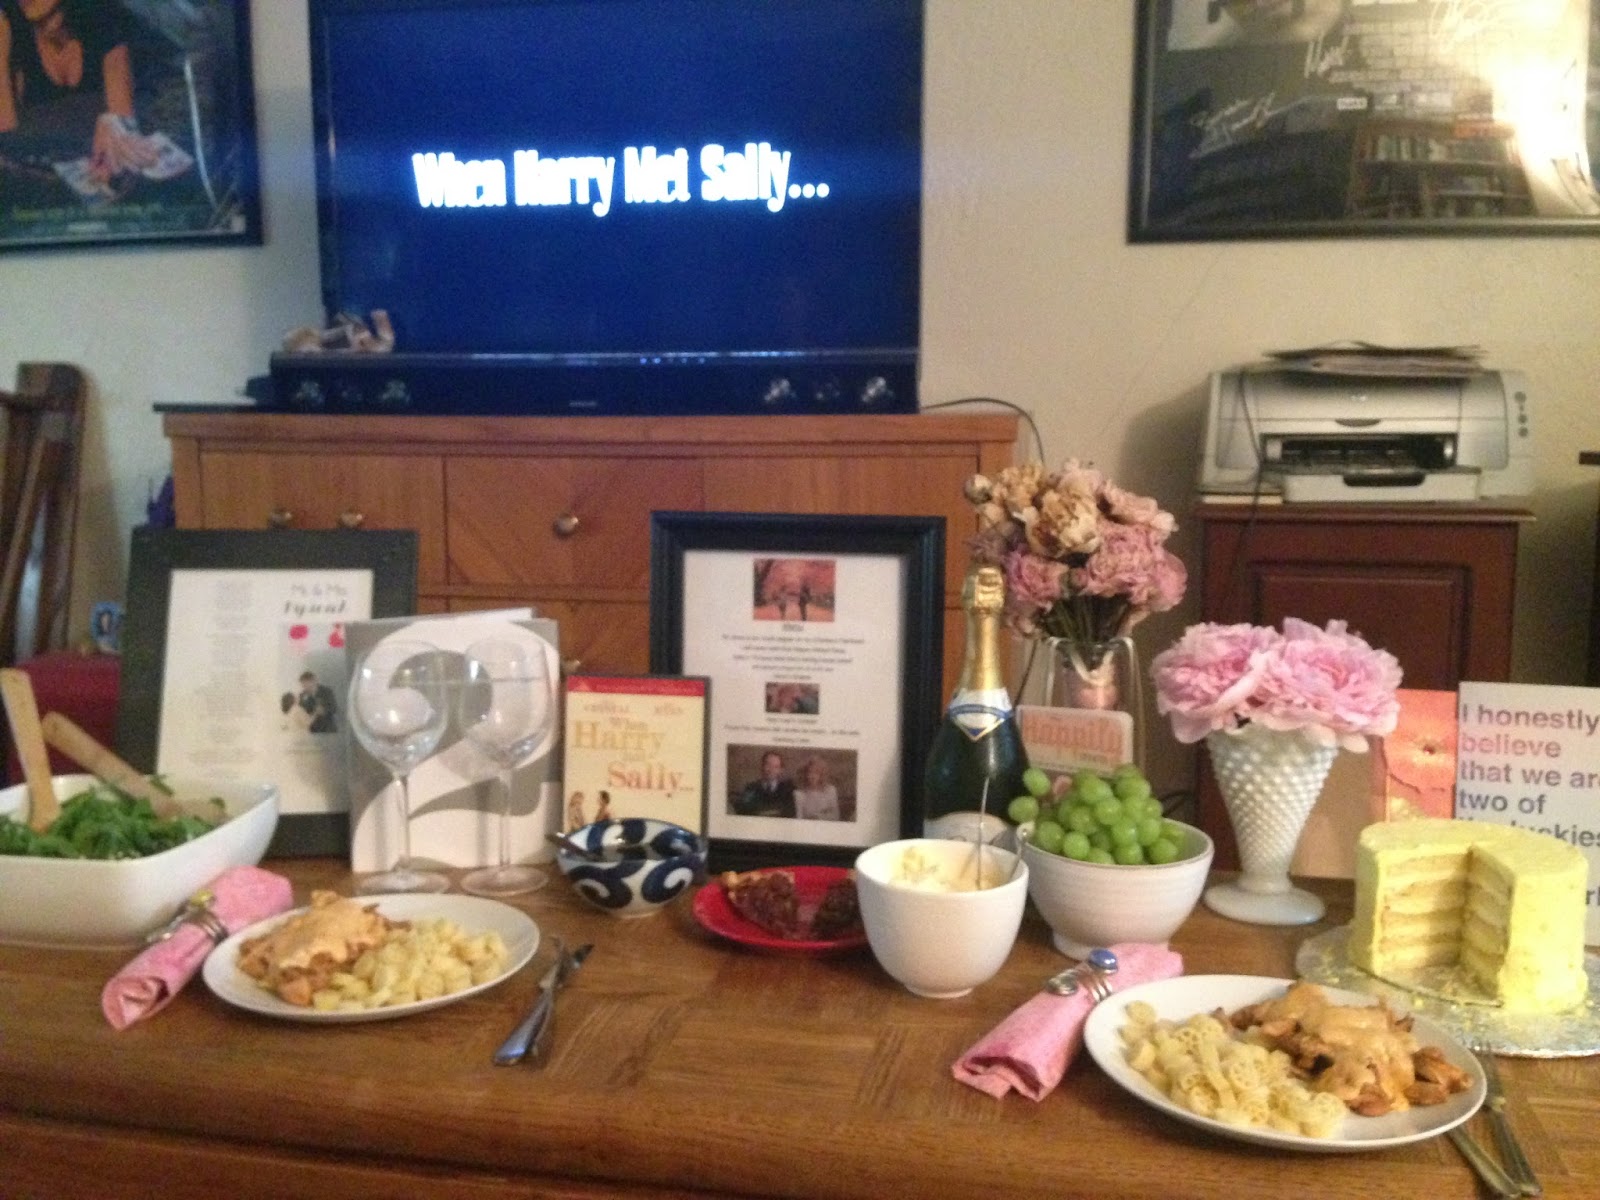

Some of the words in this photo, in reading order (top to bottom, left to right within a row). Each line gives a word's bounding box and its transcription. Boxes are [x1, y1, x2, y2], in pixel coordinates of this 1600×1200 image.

[412, 152, 507, 207] When
[513, 148, 616, 217] Harry
[624, 146, 691, 203] Met
[1462, 703, 1468, 723] I
[1477, 703, 1600, 736] honestly
[571, 721, 666, 759] Harry
[1461, 732, 1562, 758] believe
[1460, 759, 1512, 783] that
[1522, 768, 1562, 786] we
[1569, 771, 1600, 788] ar
[1459, 788, 1508, 811] two
[1518, 794, 1547, 814] of
